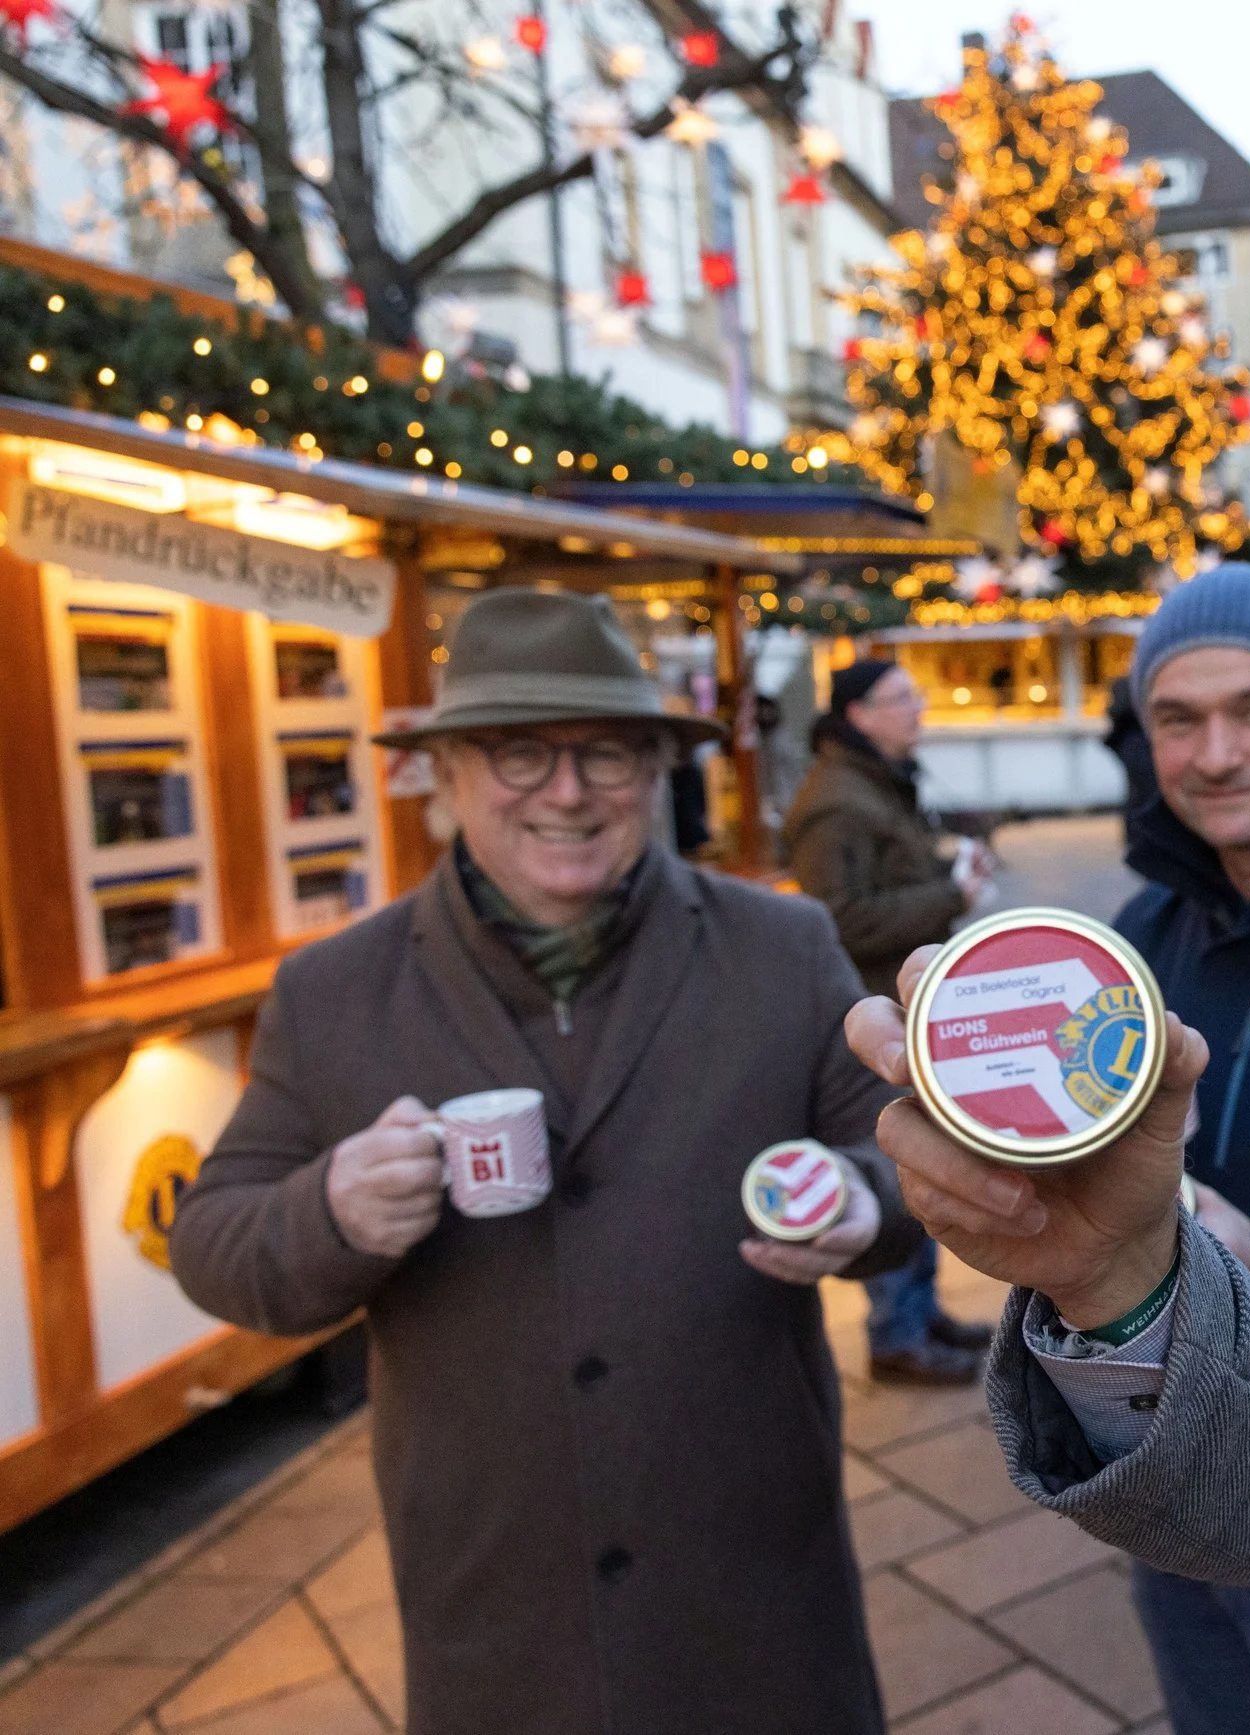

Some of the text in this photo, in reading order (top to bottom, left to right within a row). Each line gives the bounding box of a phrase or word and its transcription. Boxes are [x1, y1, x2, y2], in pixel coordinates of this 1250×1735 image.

[20, 488, 379, 616] Pfandrückgabe
[955, 976, 1041, 997] Das Bielefelder
[1021, 983, 1066, 999] Original
[938, 1019, 988, 1039] LIONS
[969, 1028, 1048, 1052] Glühwein
[472, 1156, 505, 1183] BI
